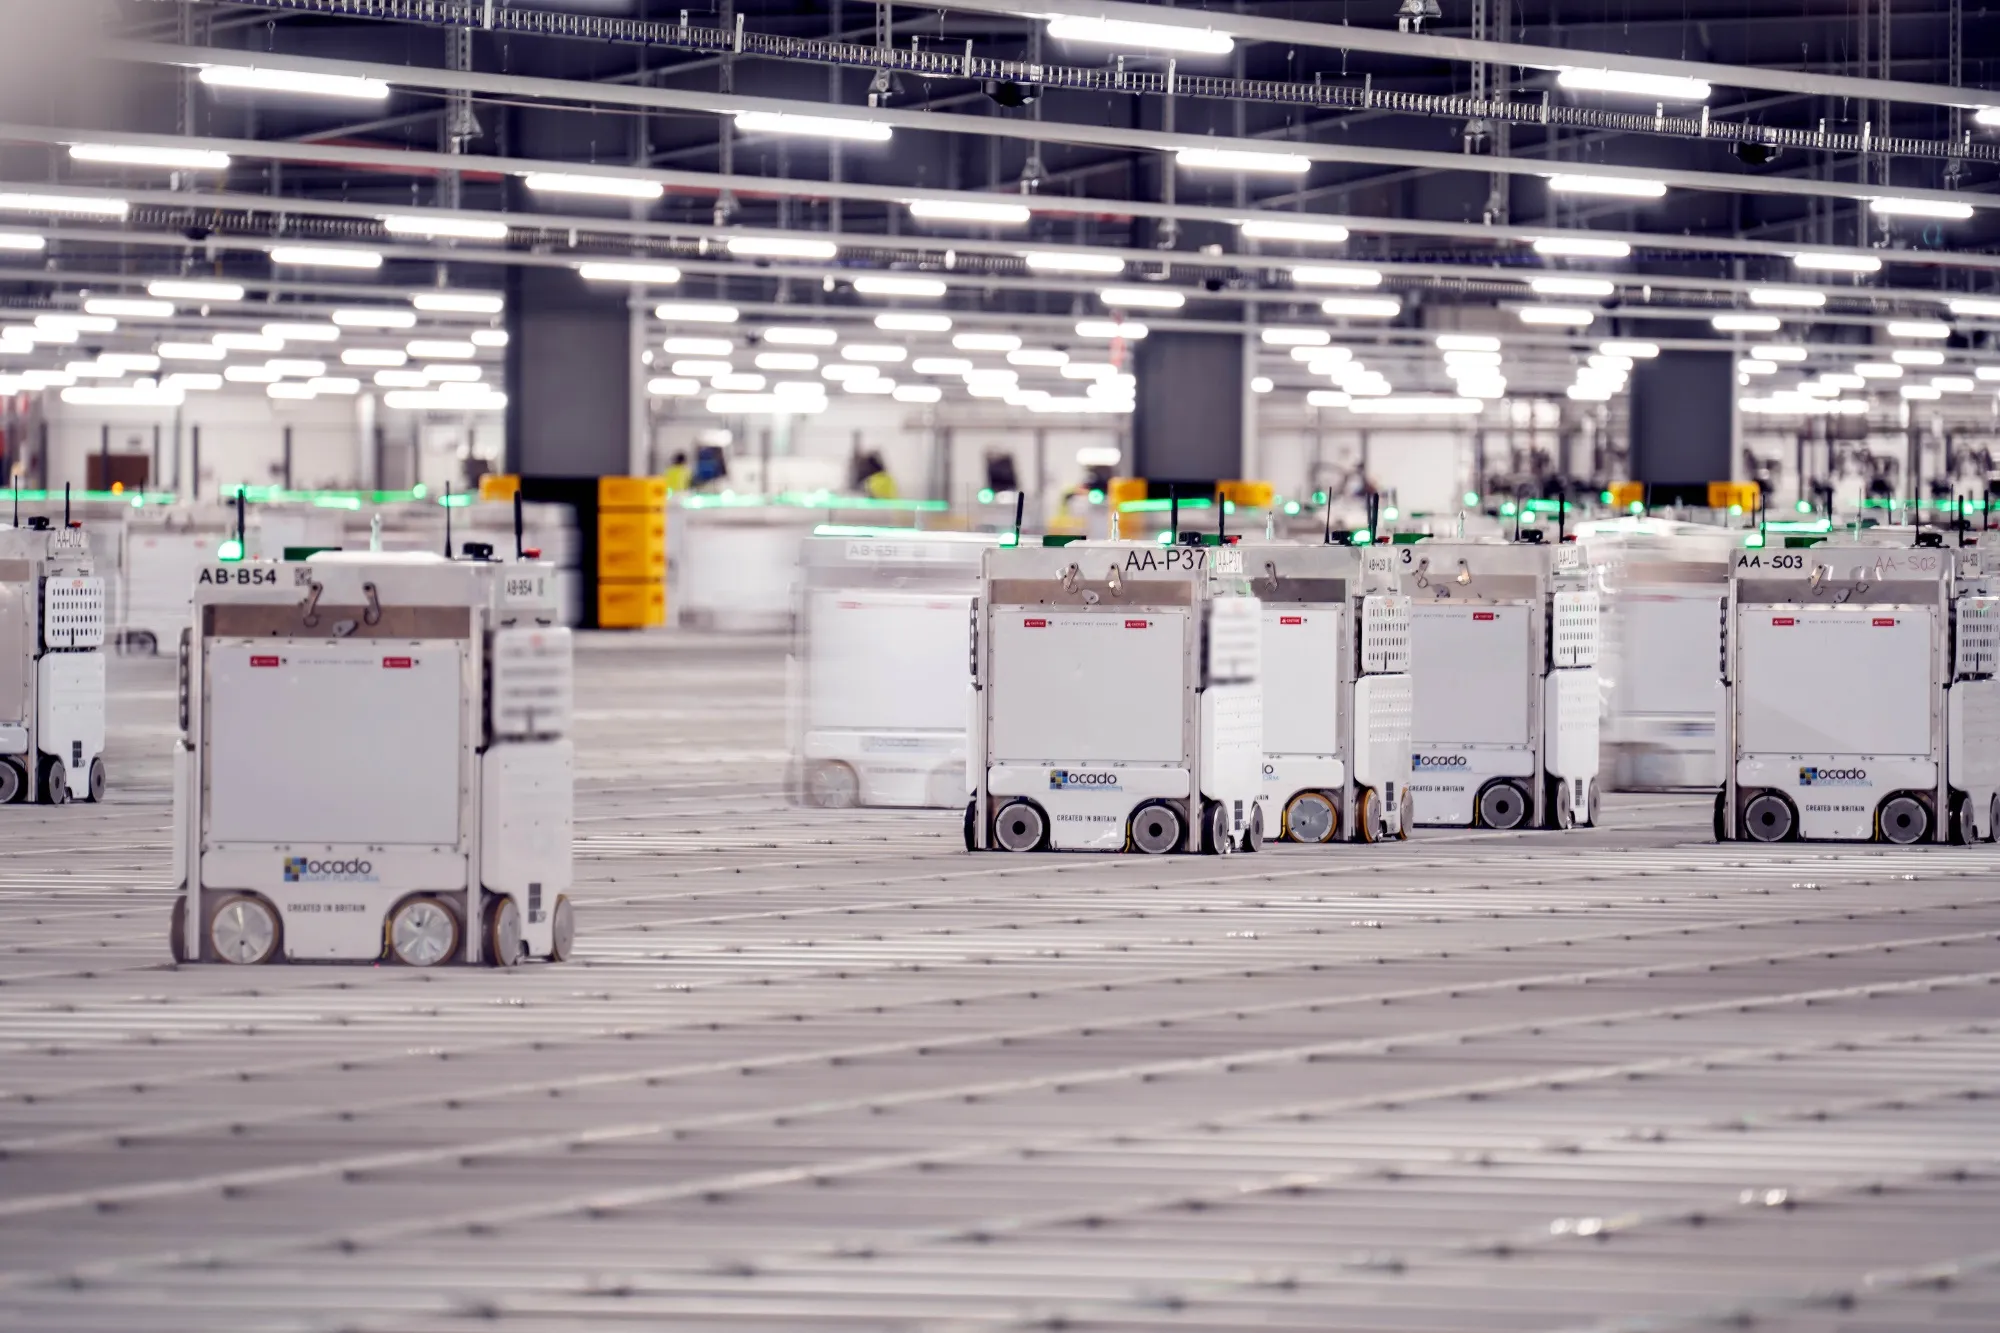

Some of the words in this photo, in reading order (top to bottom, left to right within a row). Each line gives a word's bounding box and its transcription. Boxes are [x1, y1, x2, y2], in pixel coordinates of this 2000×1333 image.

[1125, 550, 1206, 572] AA-P37
[1738, 555, 1803, 569] AA-S03
[1873, 555, 1937, 573] AA-S03
[199, 568, 277, 585] AB-B54
[1421, 754, 1467, 766] ocado
[1069, 772, 1117, 785] ocado
[1818, 767, 1866, 780] ocado
[1805, 804, 1832, 812] CREATED
[1056, 814, 1083, 822] CREATED
[308, 857, 372, 874] ocado
